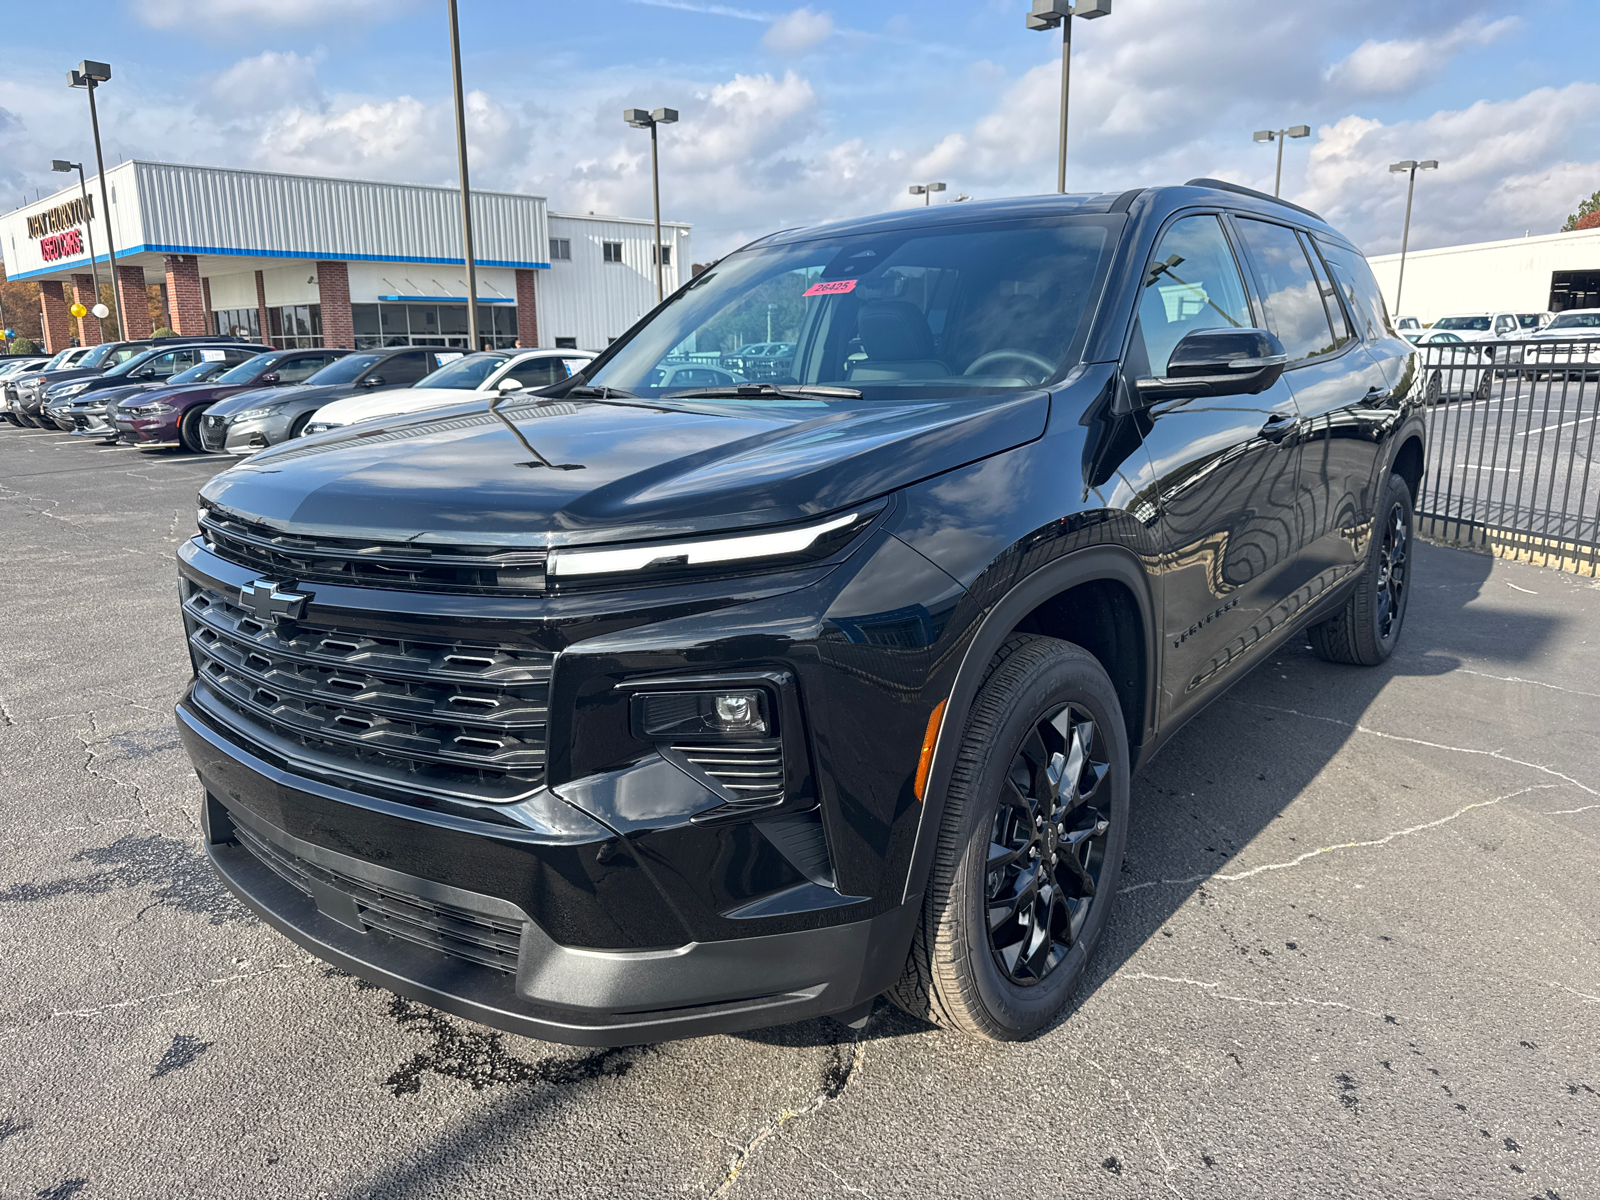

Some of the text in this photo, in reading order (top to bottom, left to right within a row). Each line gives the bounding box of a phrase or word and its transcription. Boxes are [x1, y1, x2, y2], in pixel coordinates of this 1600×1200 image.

[27, 194, 95, 239] JOHN THORNTON
[40, 229, 84, 261] USED CARS
[813, 282, 850, 292] 26425
